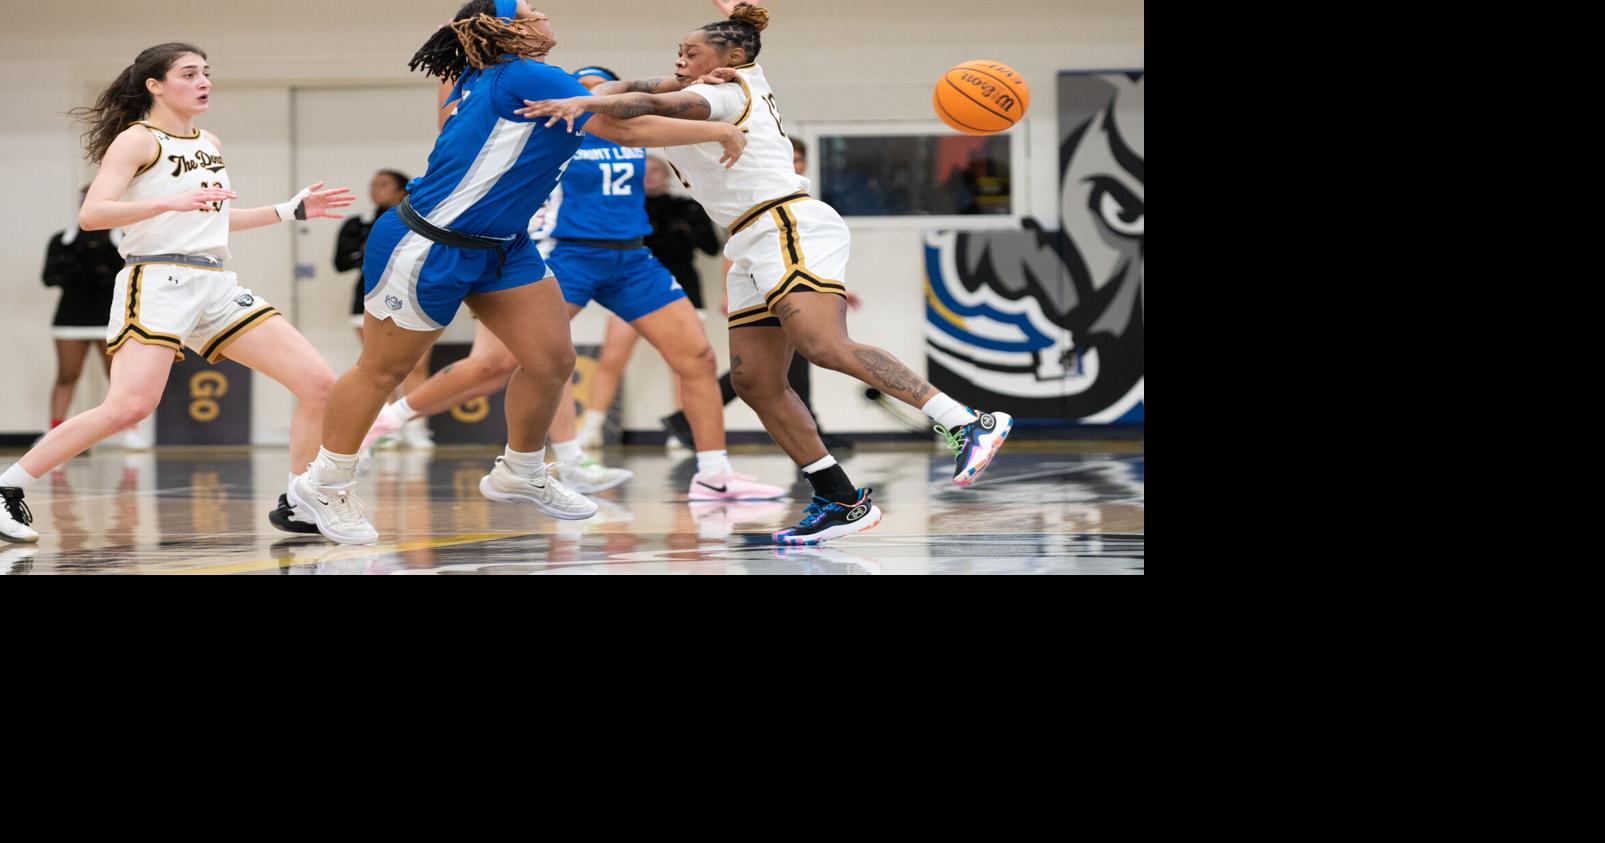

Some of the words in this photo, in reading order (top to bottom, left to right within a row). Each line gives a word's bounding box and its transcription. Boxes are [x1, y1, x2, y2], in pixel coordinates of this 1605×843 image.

[961, 73, 1015, 112] Wilson
[168, 154, 199, 178] The
[598, 162, 635, 196] 12
[188, 369, 230, 422] Go
